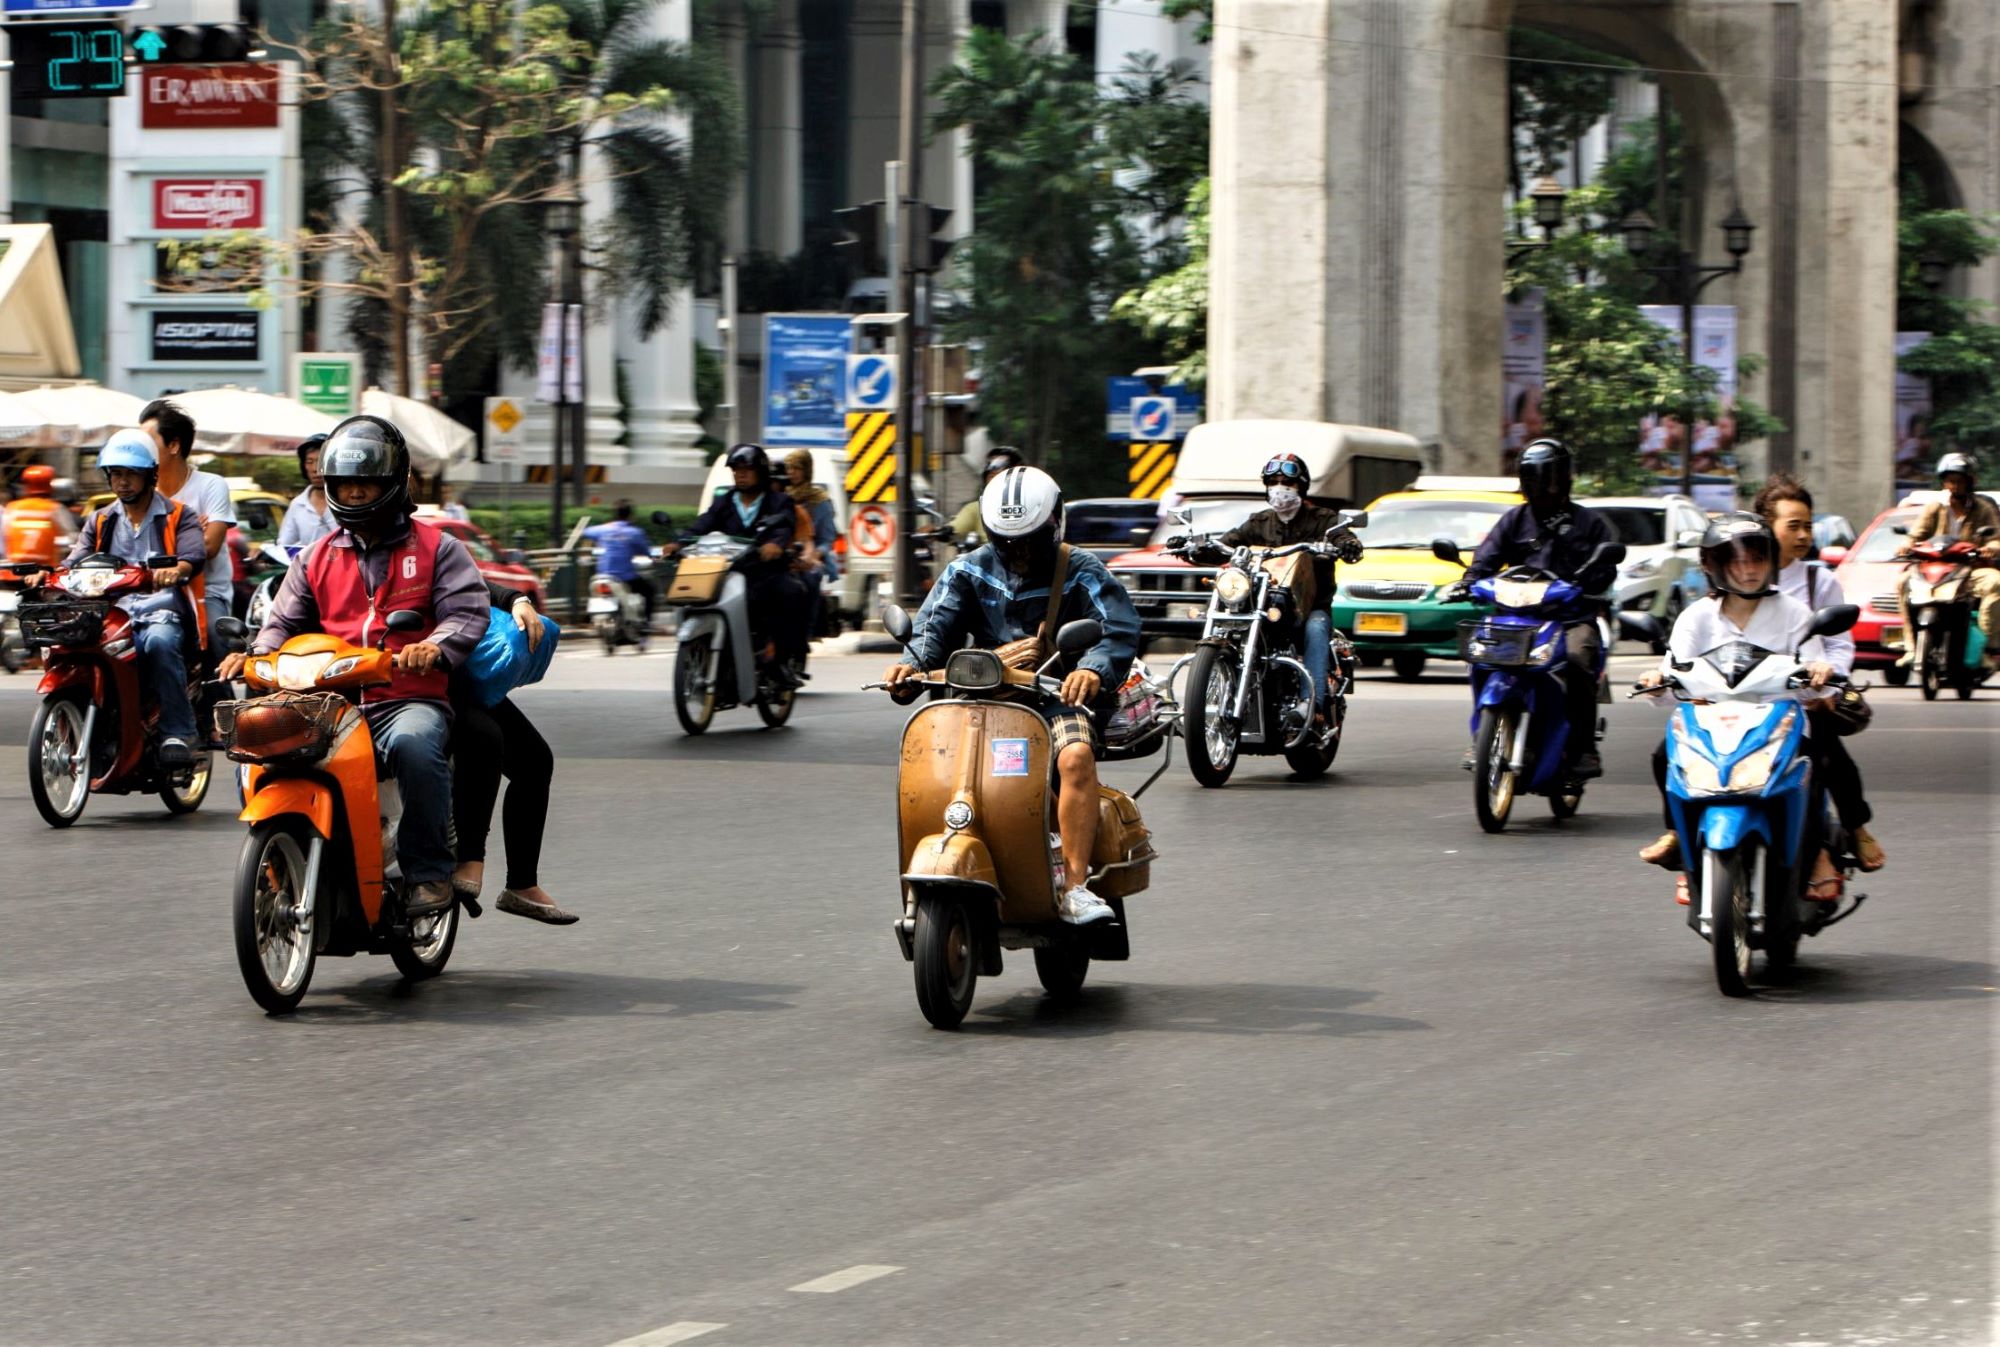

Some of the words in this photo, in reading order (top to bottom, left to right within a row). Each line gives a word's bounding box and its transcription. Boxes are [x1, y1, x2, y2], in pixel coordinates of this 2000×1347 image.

[48, 29, 122, 90] 29
[149, 76, 267, 106] ERAWAN
[402, 555, 417, 579] 6
